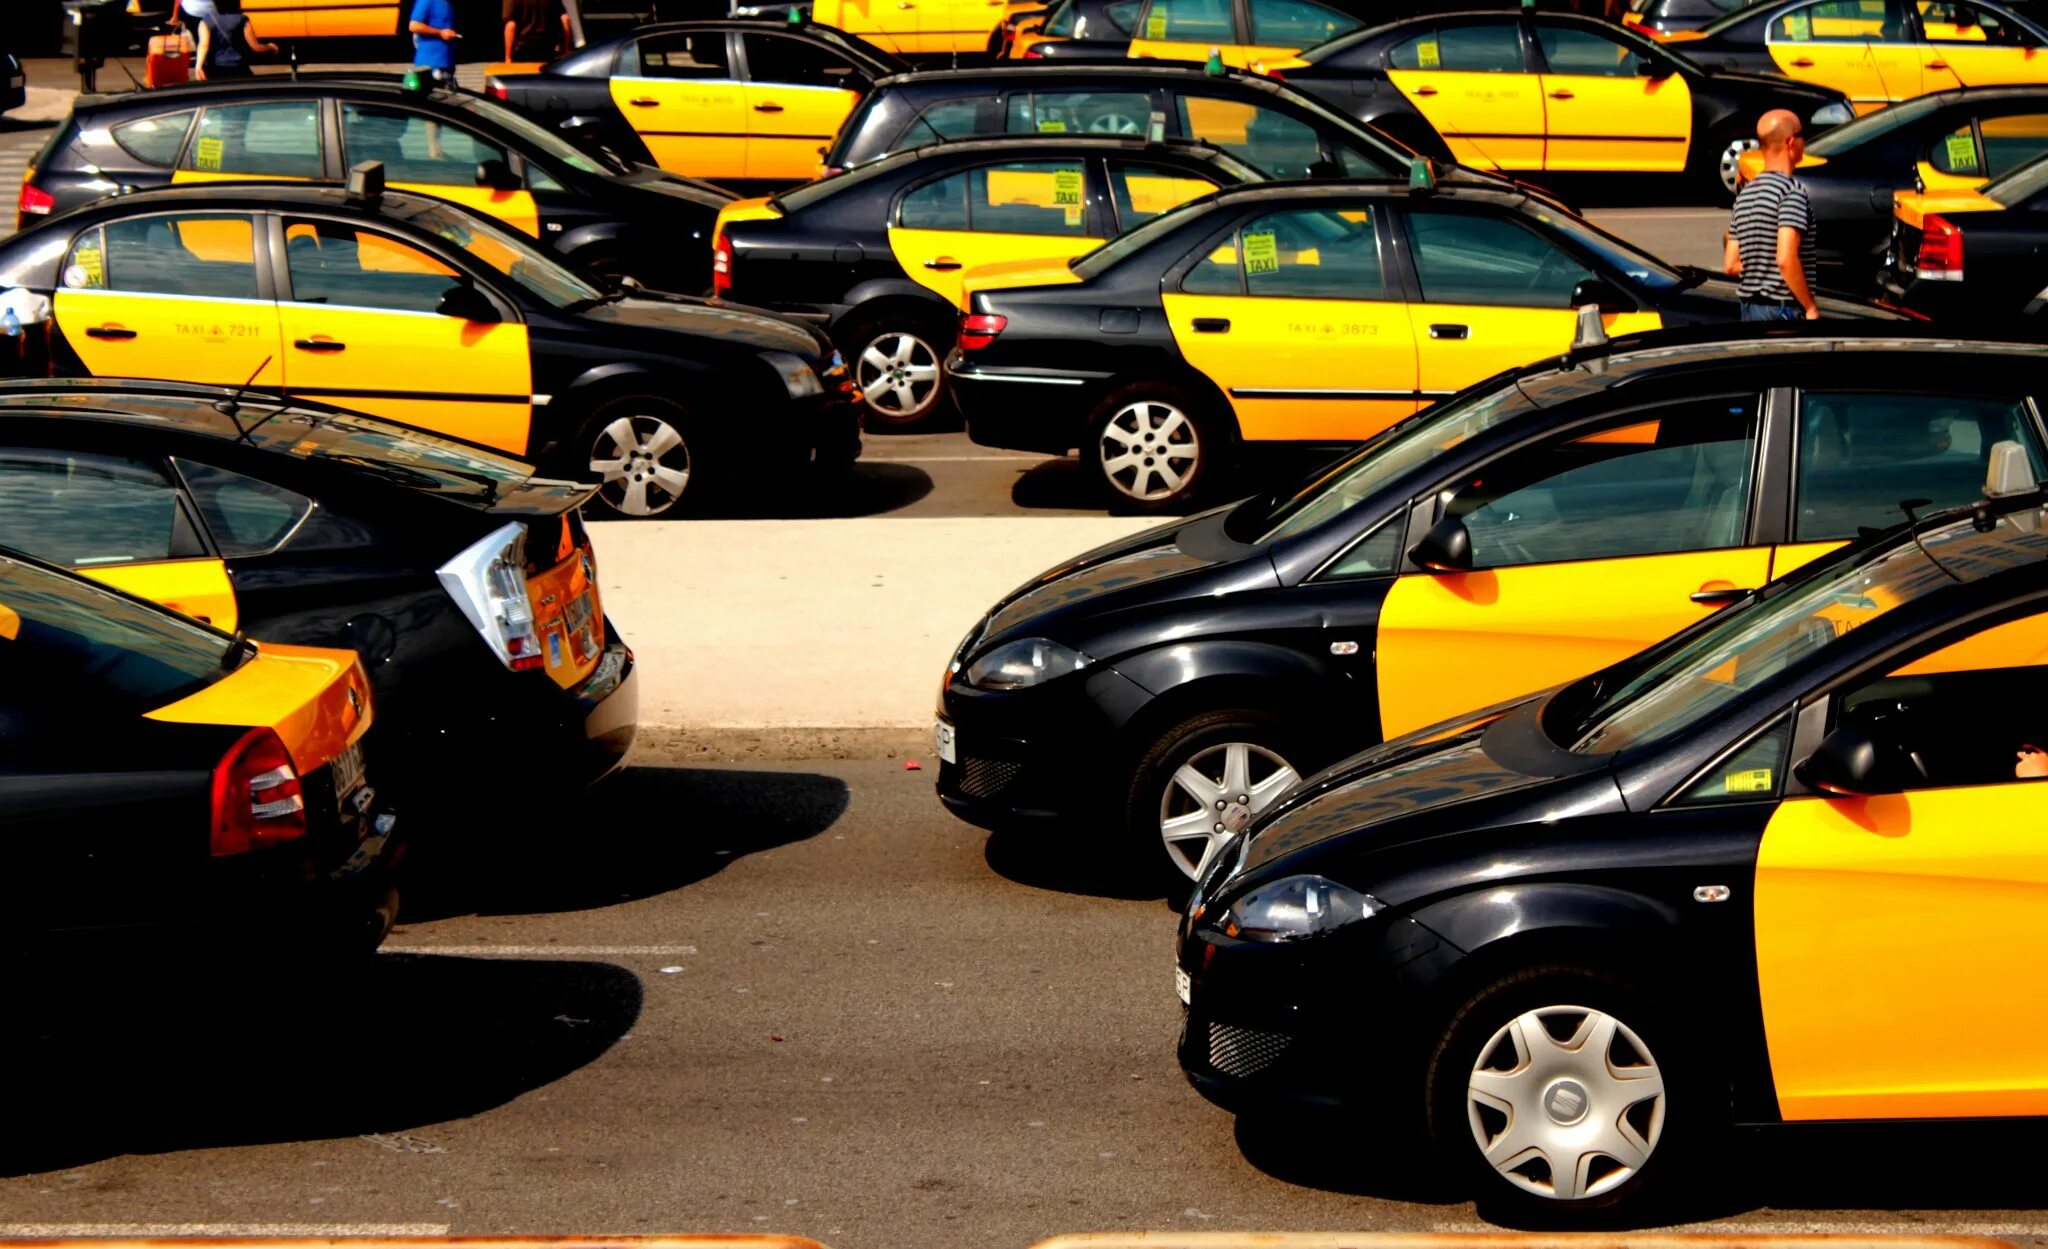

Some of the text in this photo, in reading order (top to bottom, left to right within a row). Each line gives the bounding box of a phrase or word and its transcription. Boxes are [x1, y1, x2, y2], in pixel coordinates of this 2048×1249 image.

[1952, 156, 1975, 168] TAXI
[1055, 191, 1078, 204] TAXI
[1248, 257, 1275, 272] TAXI
[175, 323, 260, 336] TAXI 7211
[1287, 323, 1379, 336] TAXI 3873
